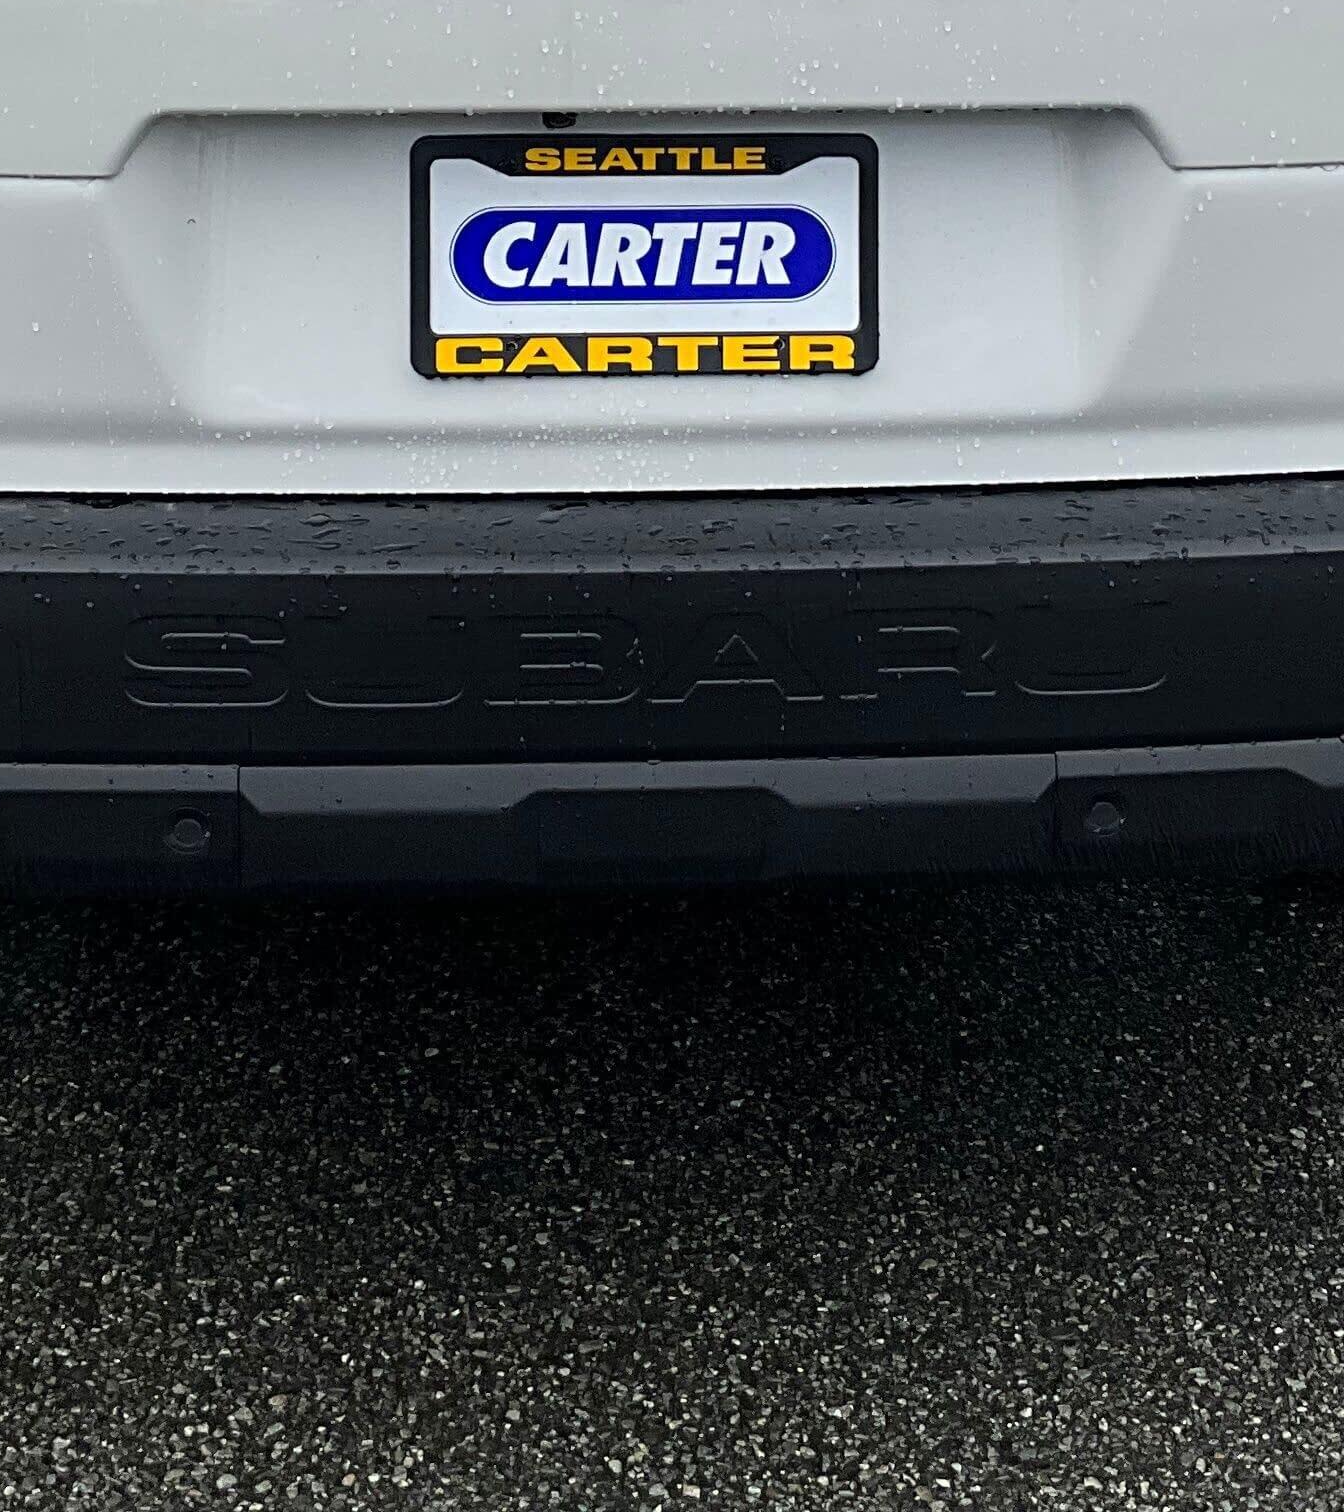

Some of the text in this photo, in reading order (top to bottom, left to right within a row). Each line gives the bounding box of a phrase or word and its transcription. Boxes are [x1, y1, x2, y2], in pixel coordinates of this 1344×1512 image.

[524, 146, 767, 172] SEATTLE
[482, 220, 797, 289] CARTER
[434, 335, 857, 374] CARTER
